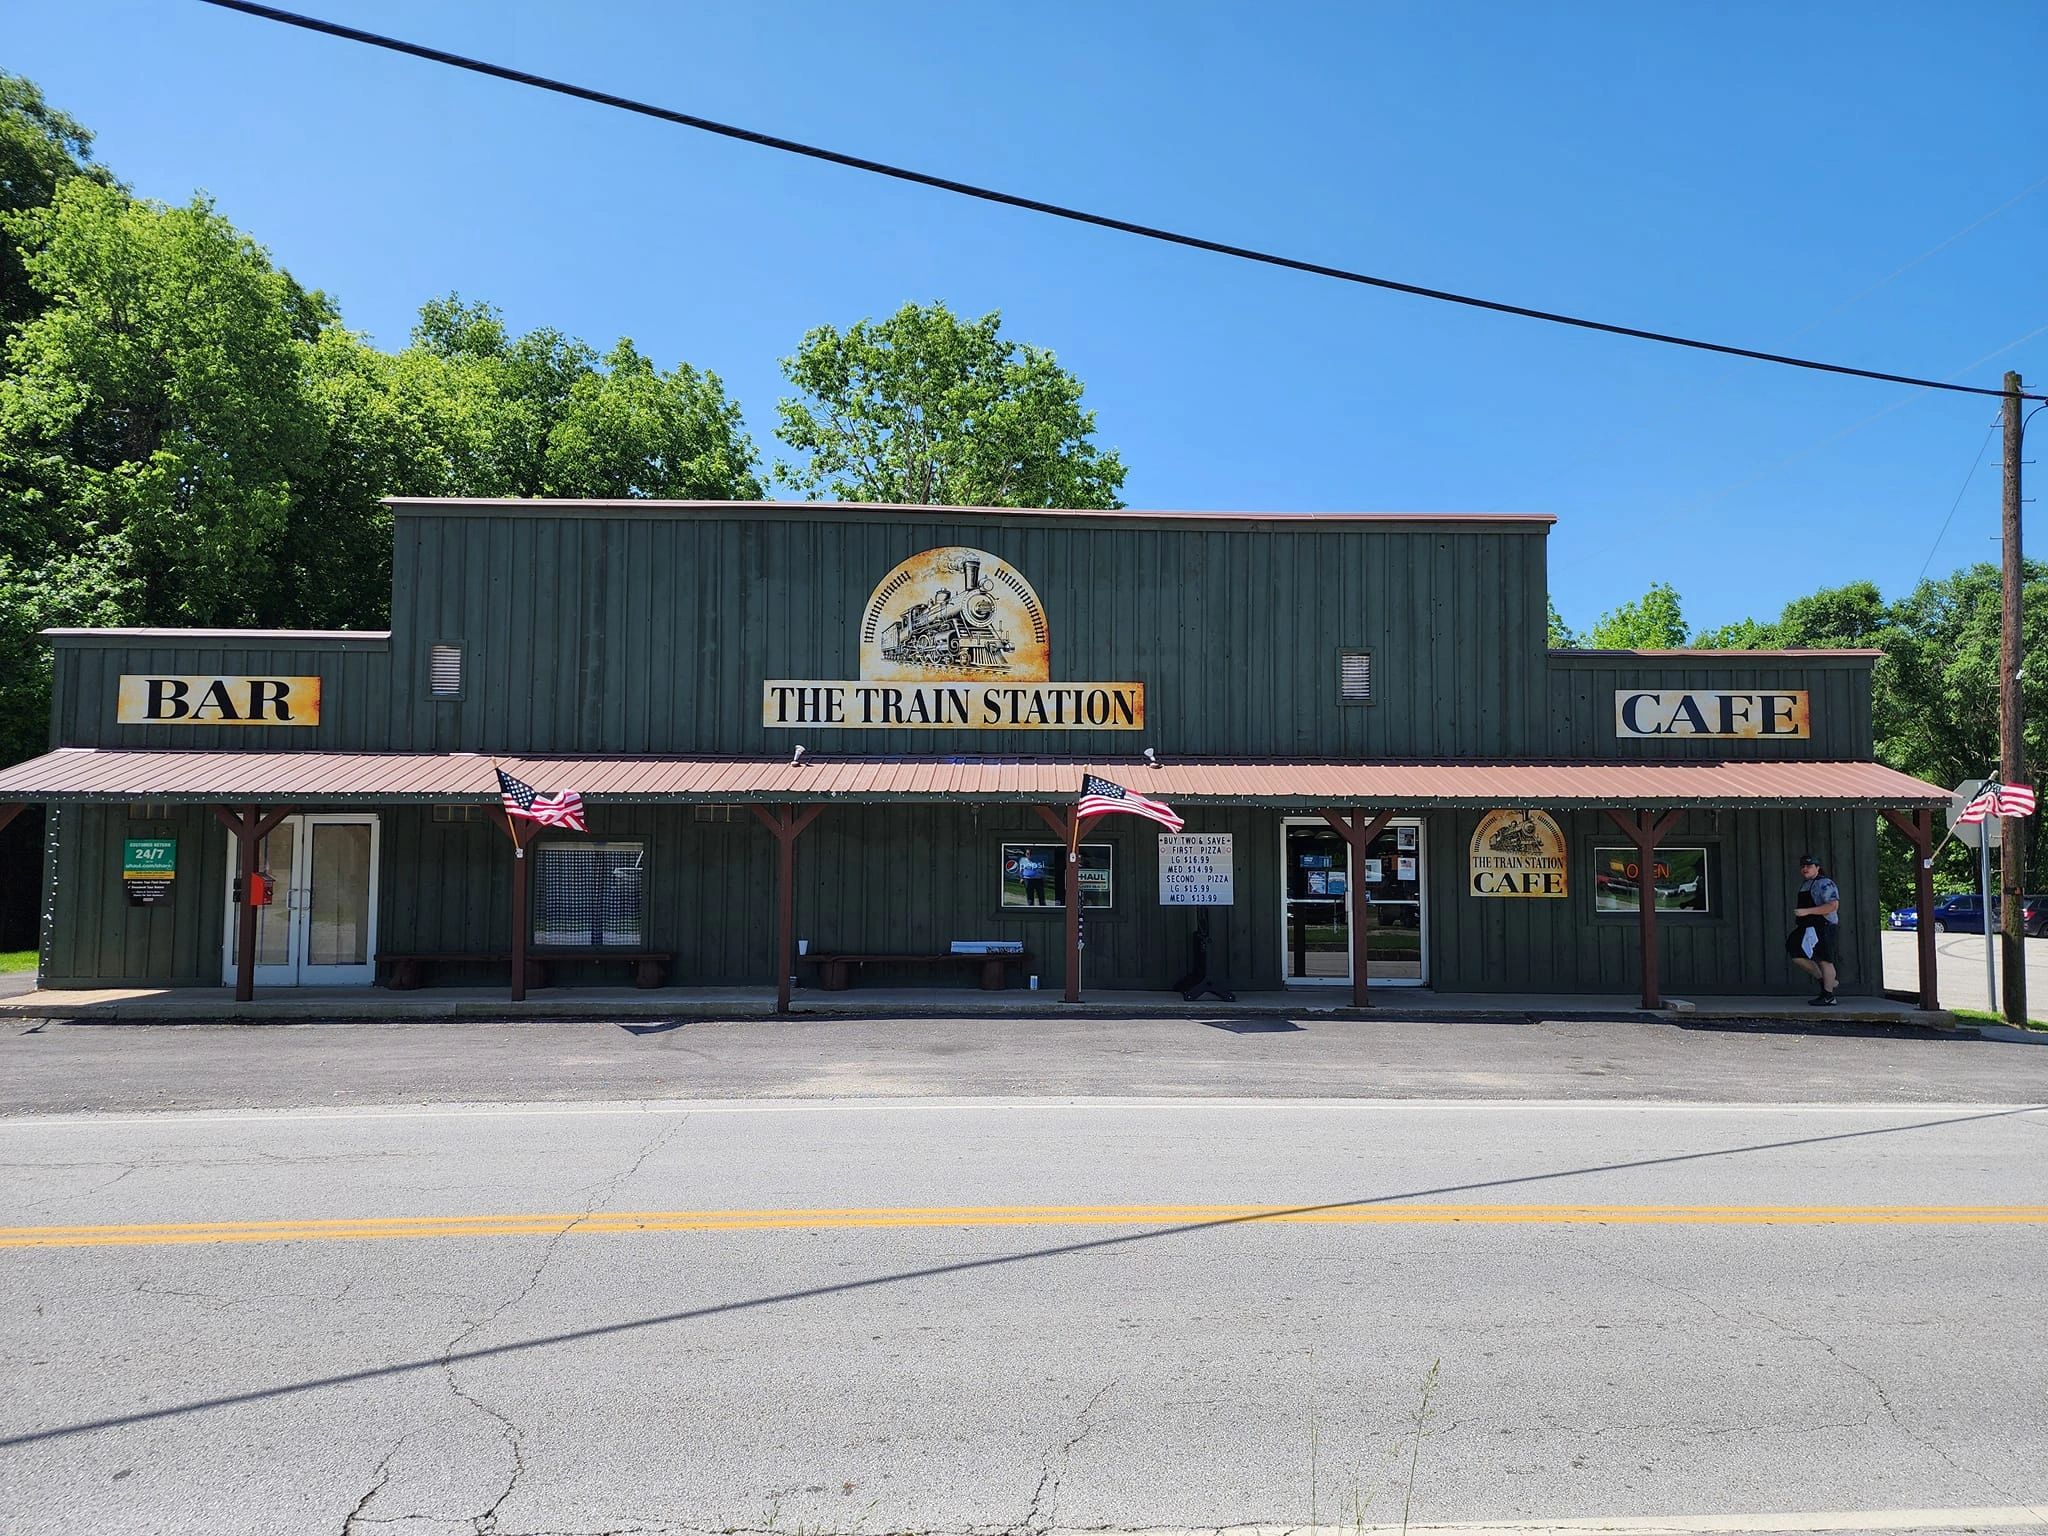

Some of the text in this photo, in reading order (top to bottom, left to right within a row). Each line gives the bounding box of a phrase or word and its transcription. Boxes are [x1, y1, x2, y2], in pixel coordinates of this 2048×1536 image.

[143, 679, 296, 721] BAR
[771, 687, 1136, 726] THE TRAIN STATION
[1622, 693, 1799, 735] CAFE
[1164, 837, 1226, 845] BUY TWO & SAVE
[135, 849, 164, 860] 24/7
[1172, 846, 1193, 854] FIRST
[1020, 860, 1045, 870] pepsi
[1172, 856, 1210, 864] LG $16.99
[1473, 856, 1564, 869] THE TRAIN STATION
[1166, 875, 1229, 883] SECOND PIZZA
[1473, 872, 1563, 894] CAFE
[1184, 885, 1210, 893] $15.99
[1170, 894, 1185, 902] MED
